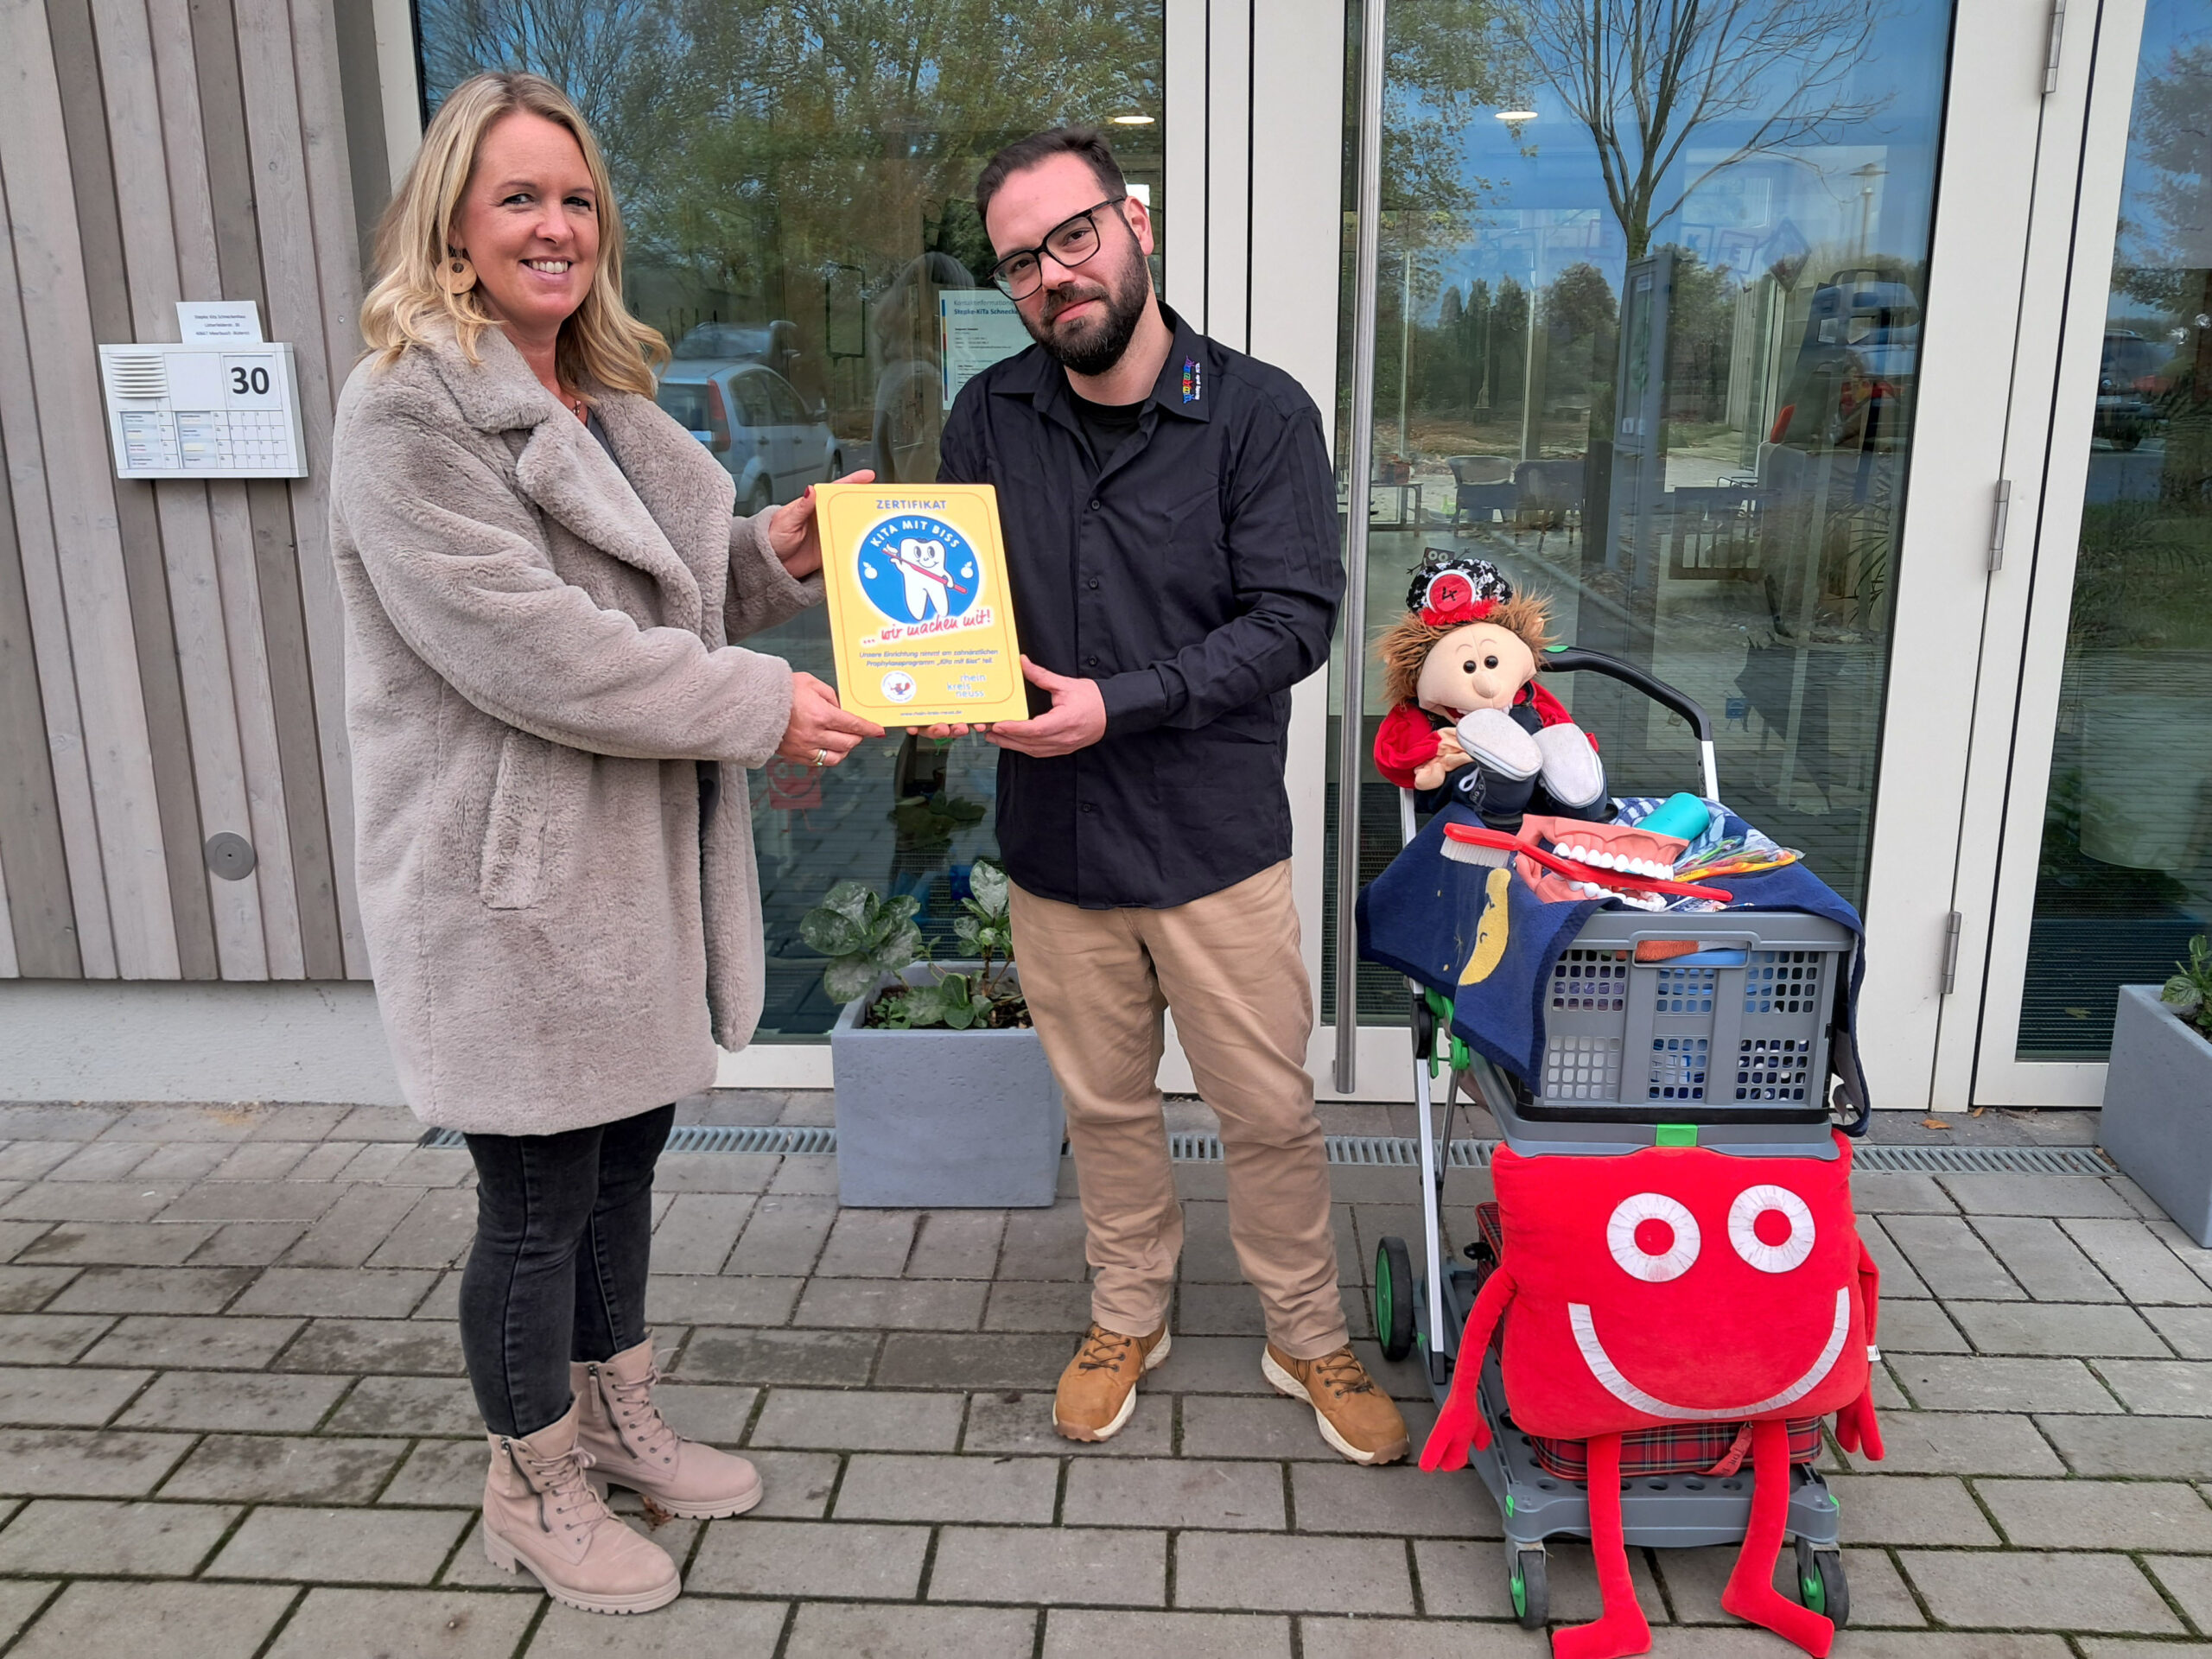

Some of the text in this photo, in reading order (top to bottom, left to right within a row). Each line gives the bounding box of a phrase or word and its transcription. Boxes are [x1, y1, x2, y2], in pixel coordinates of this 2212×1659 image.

[230, 366, 270, 395] 30
[876, 499, 947, 510] ZERTIFIKAT
[870, 519, 960, 549] KITA MIT BISS
[881, 624, 903, 640] wir
[907, 614, 958, 636] machen
[963, 609, 991, 629] mit!
[884, 650, 918, 659] Einrichtung
[960, 673, 986, 683] rhein
[947, 682, 971, 691] kreis
